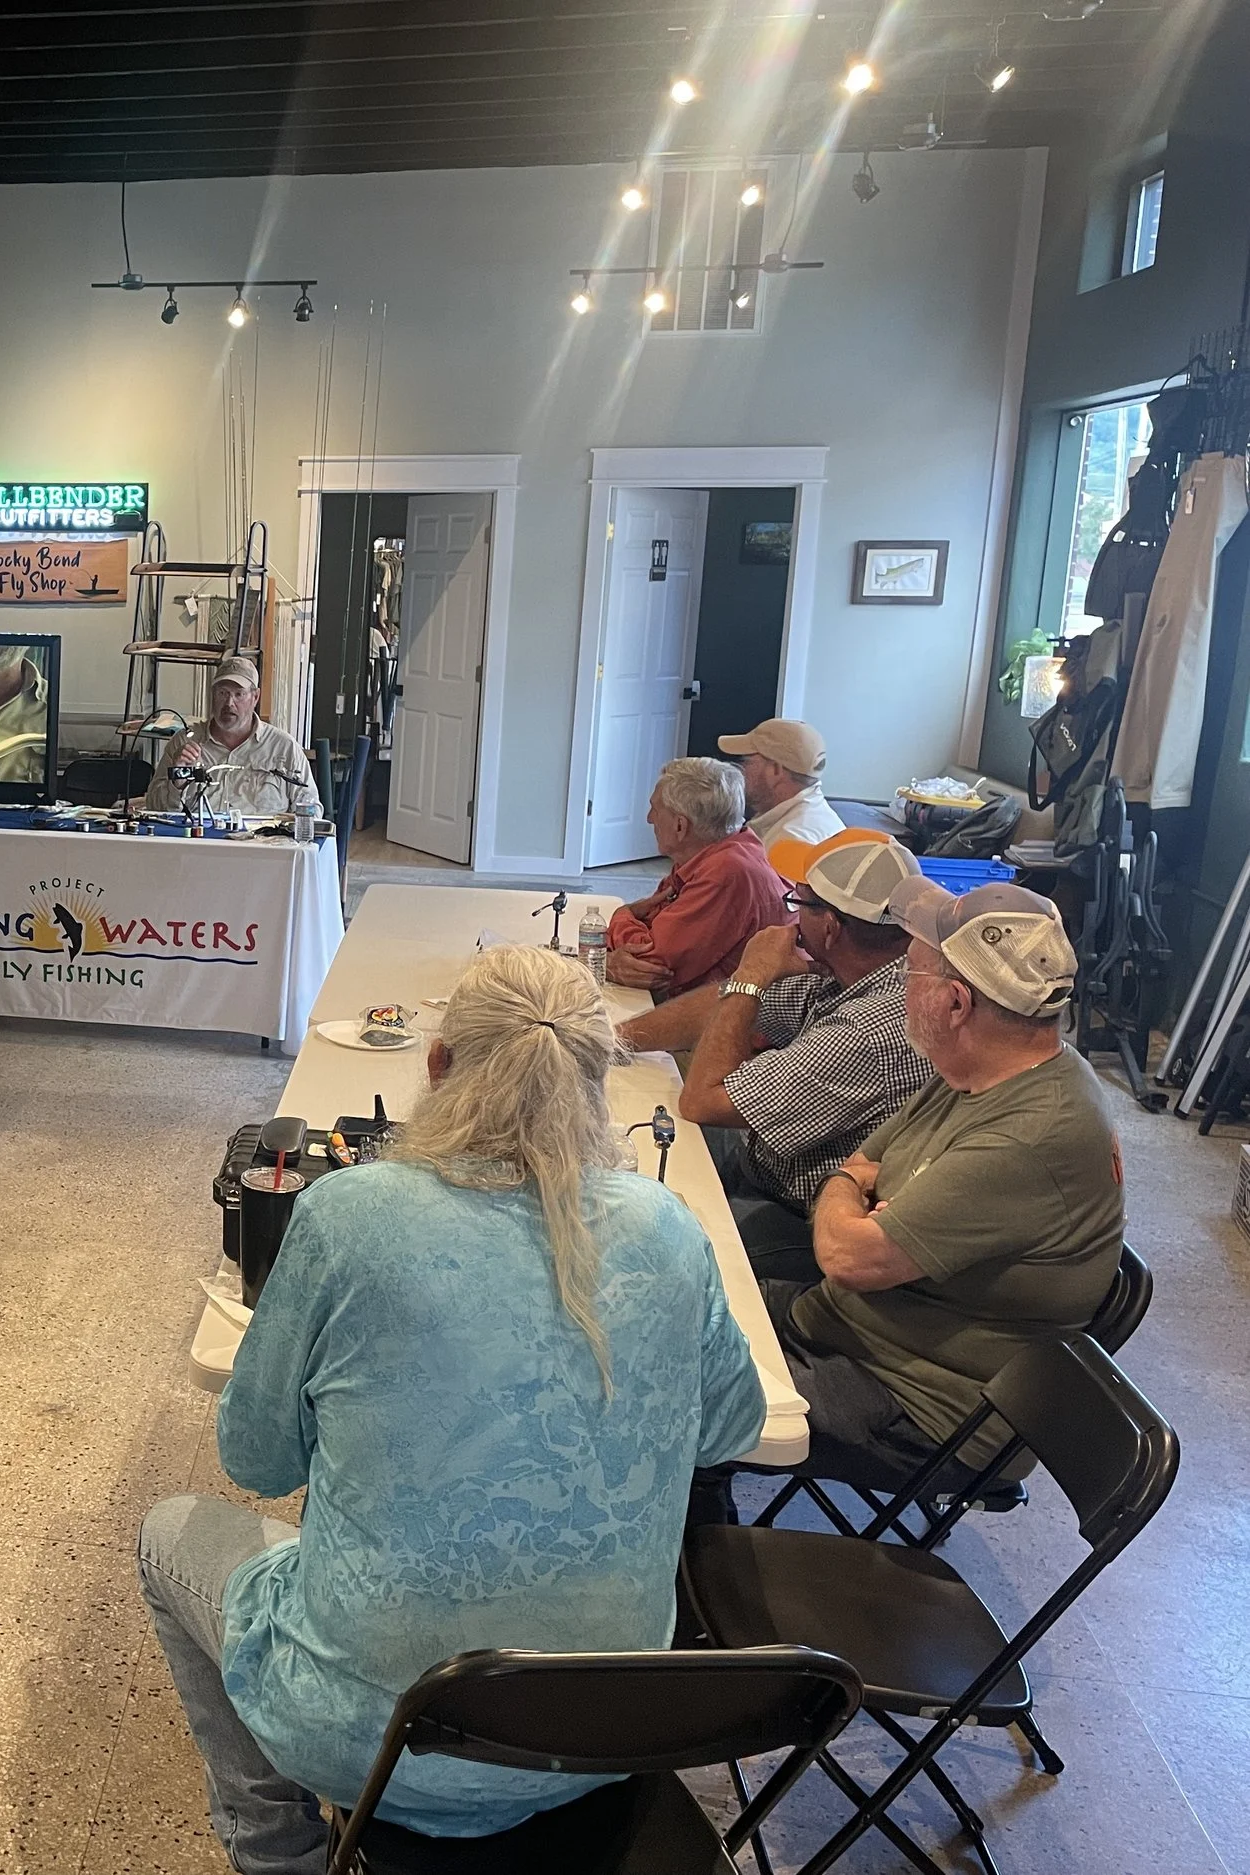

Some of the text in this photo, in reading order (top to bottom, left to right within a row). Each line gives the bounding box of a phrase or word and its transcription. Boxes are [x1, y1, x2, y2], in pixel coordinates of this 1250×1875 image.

[36, 546, 81, 570] Bend
[30, 571, 67, 596] Shop
[29, 877, 105, 898] PROJECT
[99, 916, 259, 952] WATERS
[43, 964, 144, 988] FISHING
